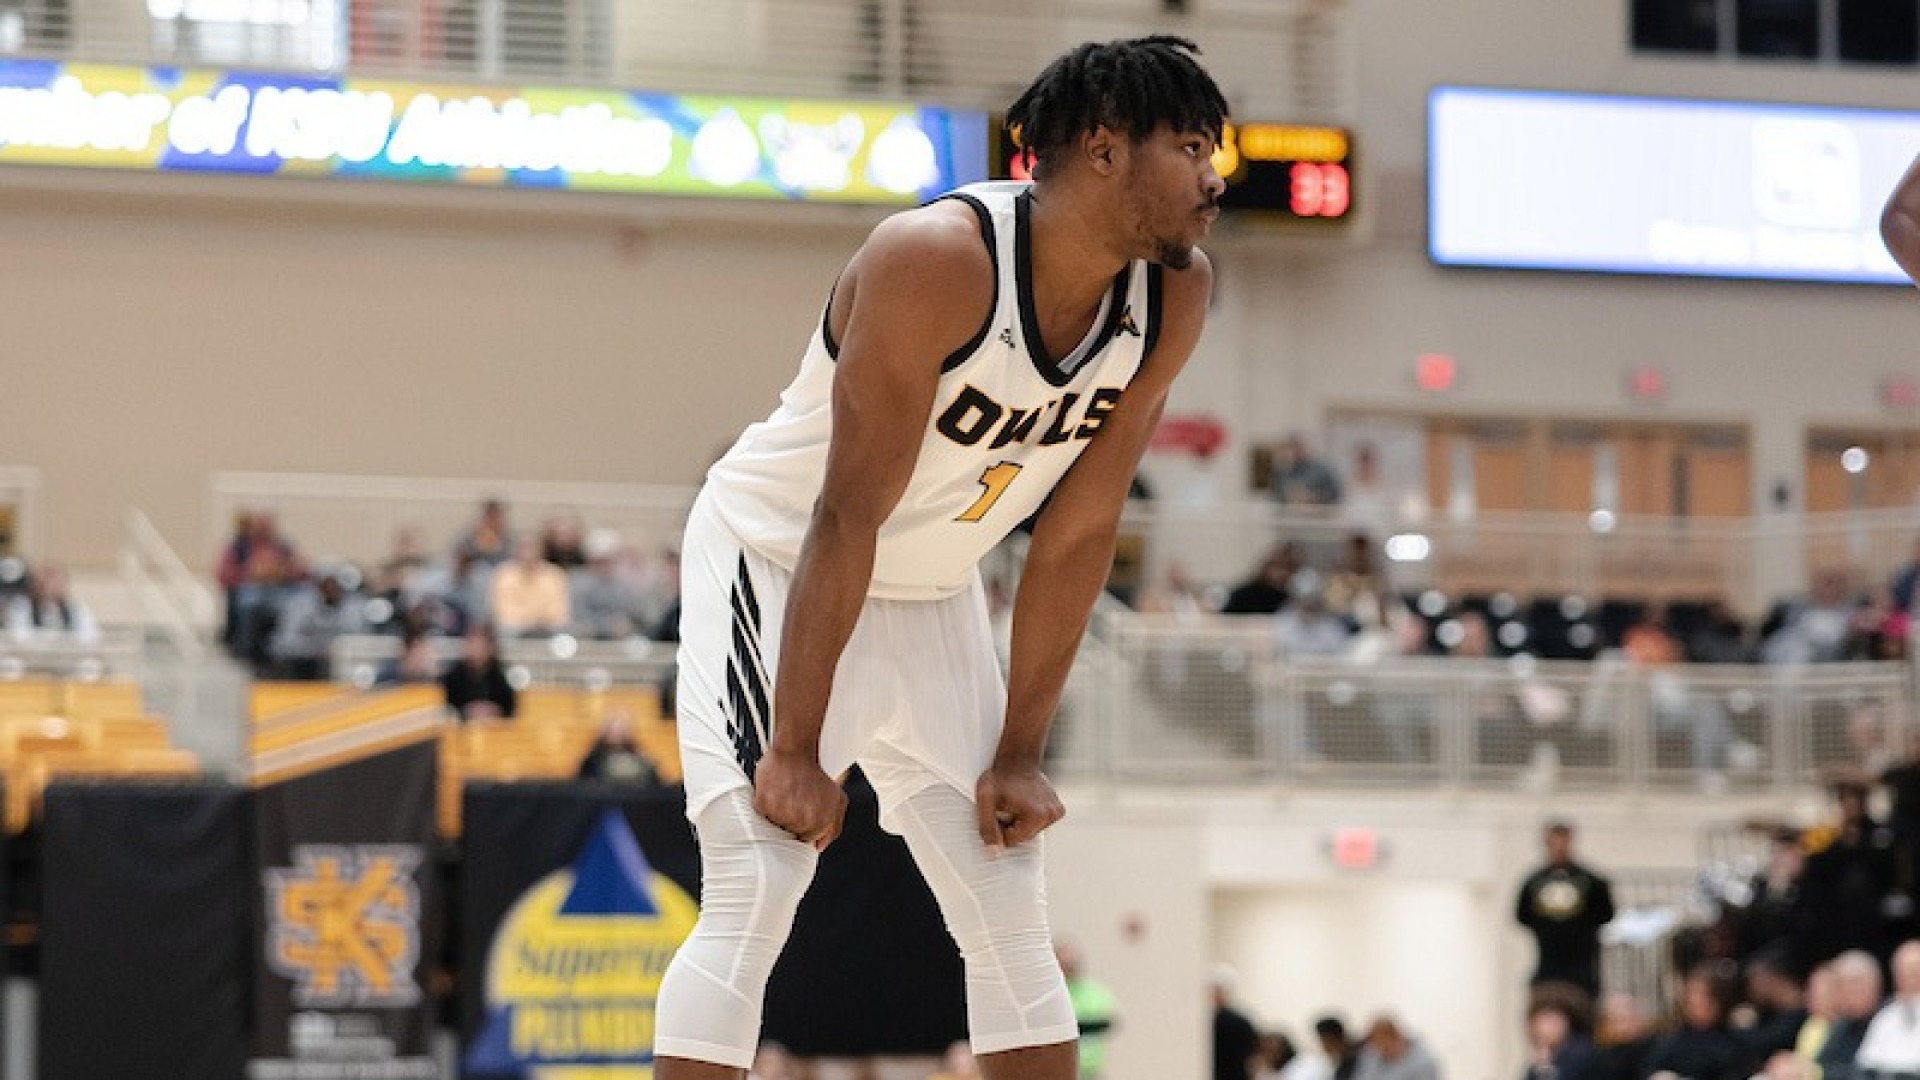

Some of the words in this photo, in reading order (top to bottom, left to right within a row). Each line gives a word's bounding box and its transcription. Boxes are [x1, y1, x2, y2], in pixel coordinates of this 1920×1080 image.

[169, 84, 250, 155] of
[246, 86, 393, 162] KSU
[386, 94, 672, 176] Athletics
[936, 383, 1122, 449] OWLS
[951, 460, 1023, 523] 1
